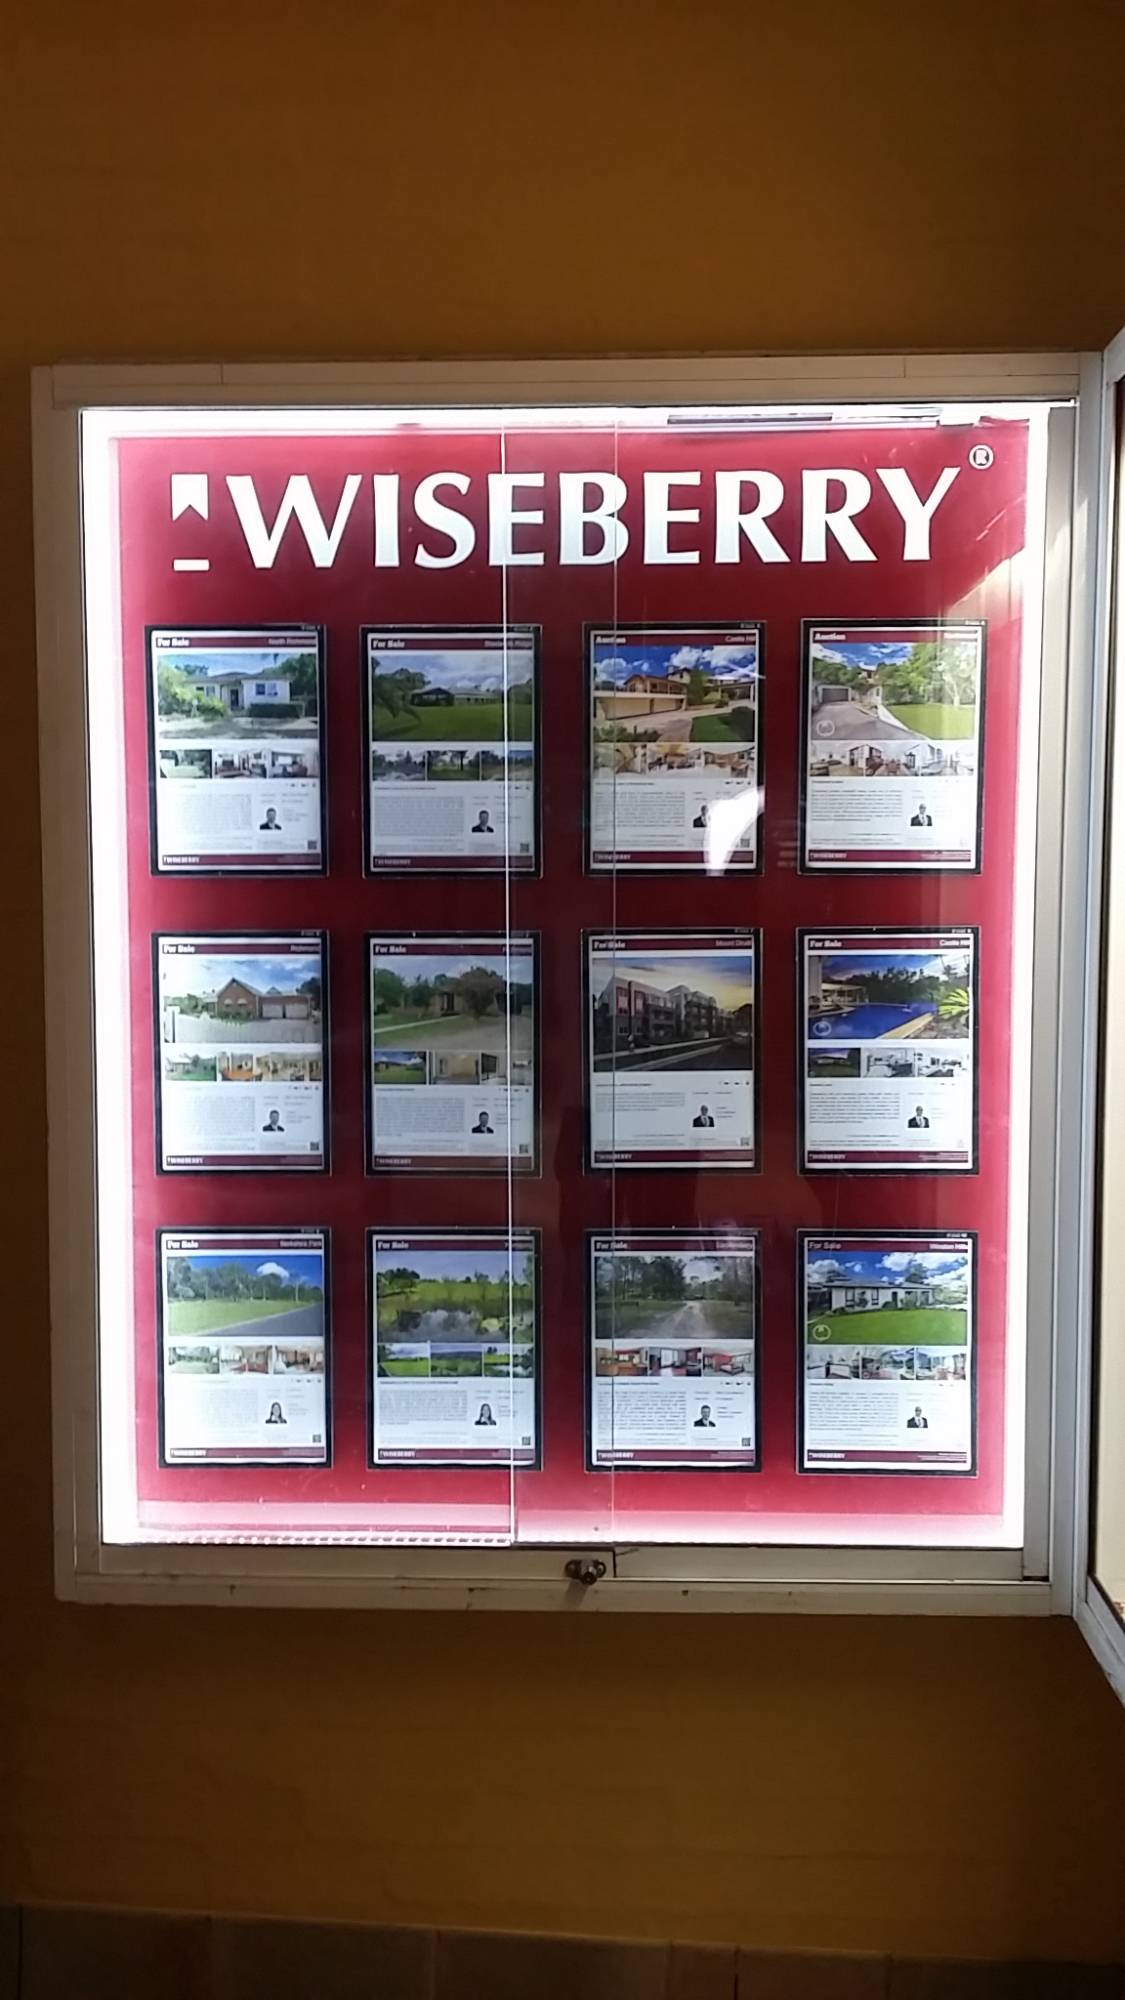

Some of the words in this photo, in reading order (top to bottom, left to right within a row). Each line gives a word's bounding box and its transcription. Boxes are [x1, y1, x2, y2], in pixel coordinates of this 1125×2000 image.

[226, 466, 960, 569] WISEBERRY
[814, 633, 846, 641] Auction
[157, 638, 170, 647] For
[373, 640, 386, 648] For
[163, 945, 176, 953] For
[375, 945, 388, 953] For
[167, 1240, 180, 1249] For
[378, 1241, 390, 1249] For
[809, 1241, 822, 1249] For
